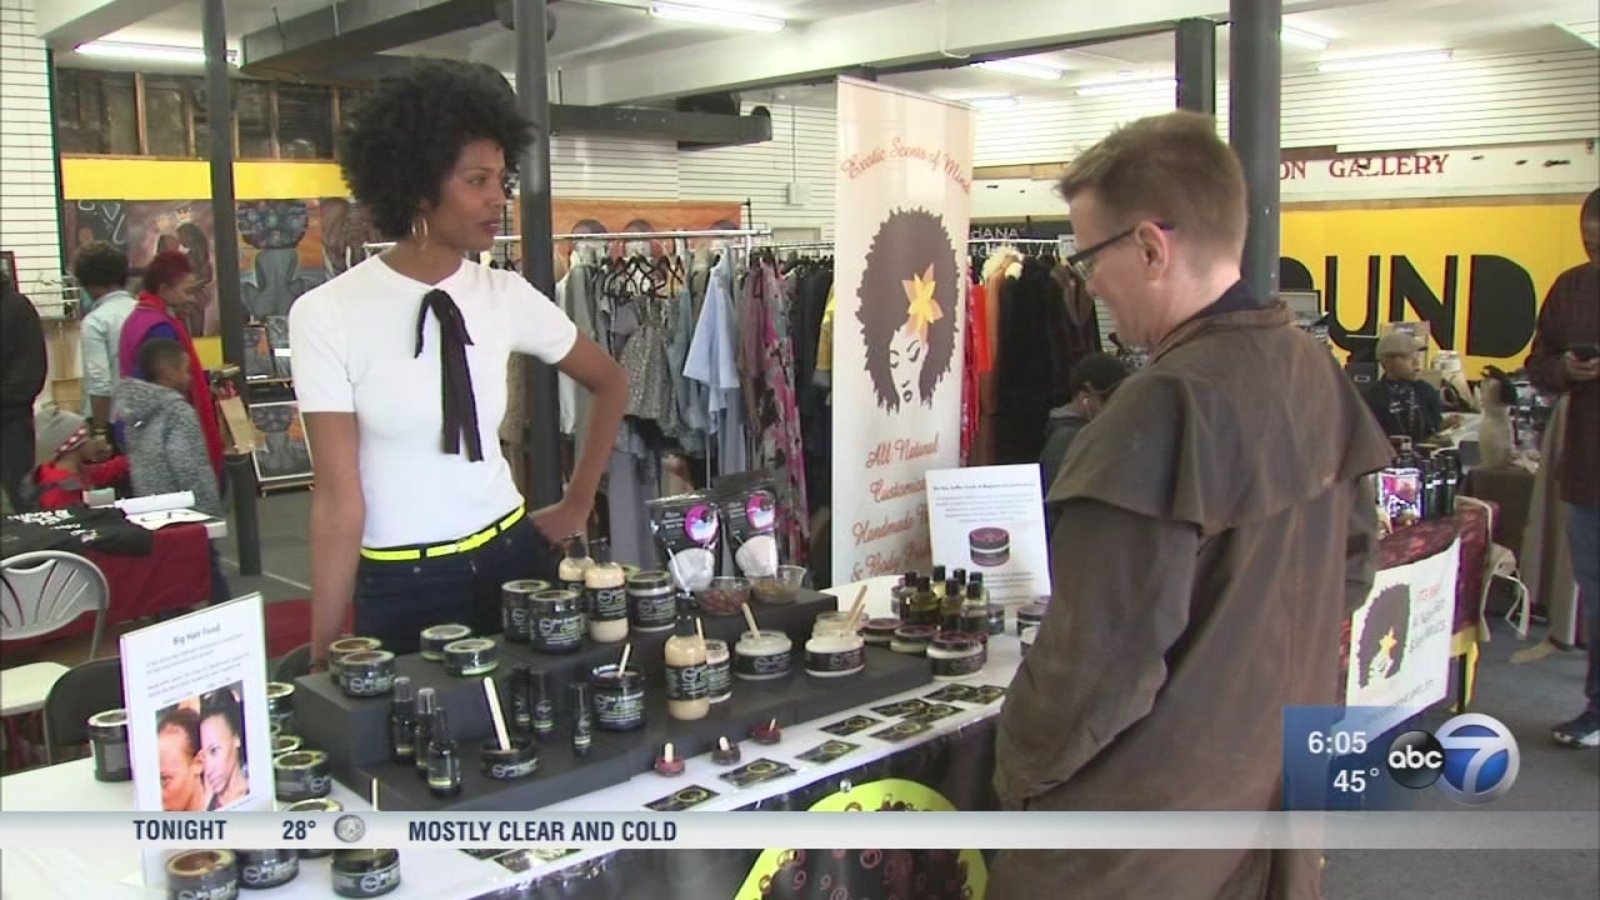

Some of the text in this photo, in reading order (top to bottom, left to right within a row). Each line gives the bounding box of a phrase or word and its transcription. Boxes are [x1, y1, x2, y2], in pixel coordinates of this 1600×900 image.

[1328, 154, 1450, 178] GALLERY
[866, 432, 940, 468] All Natural
